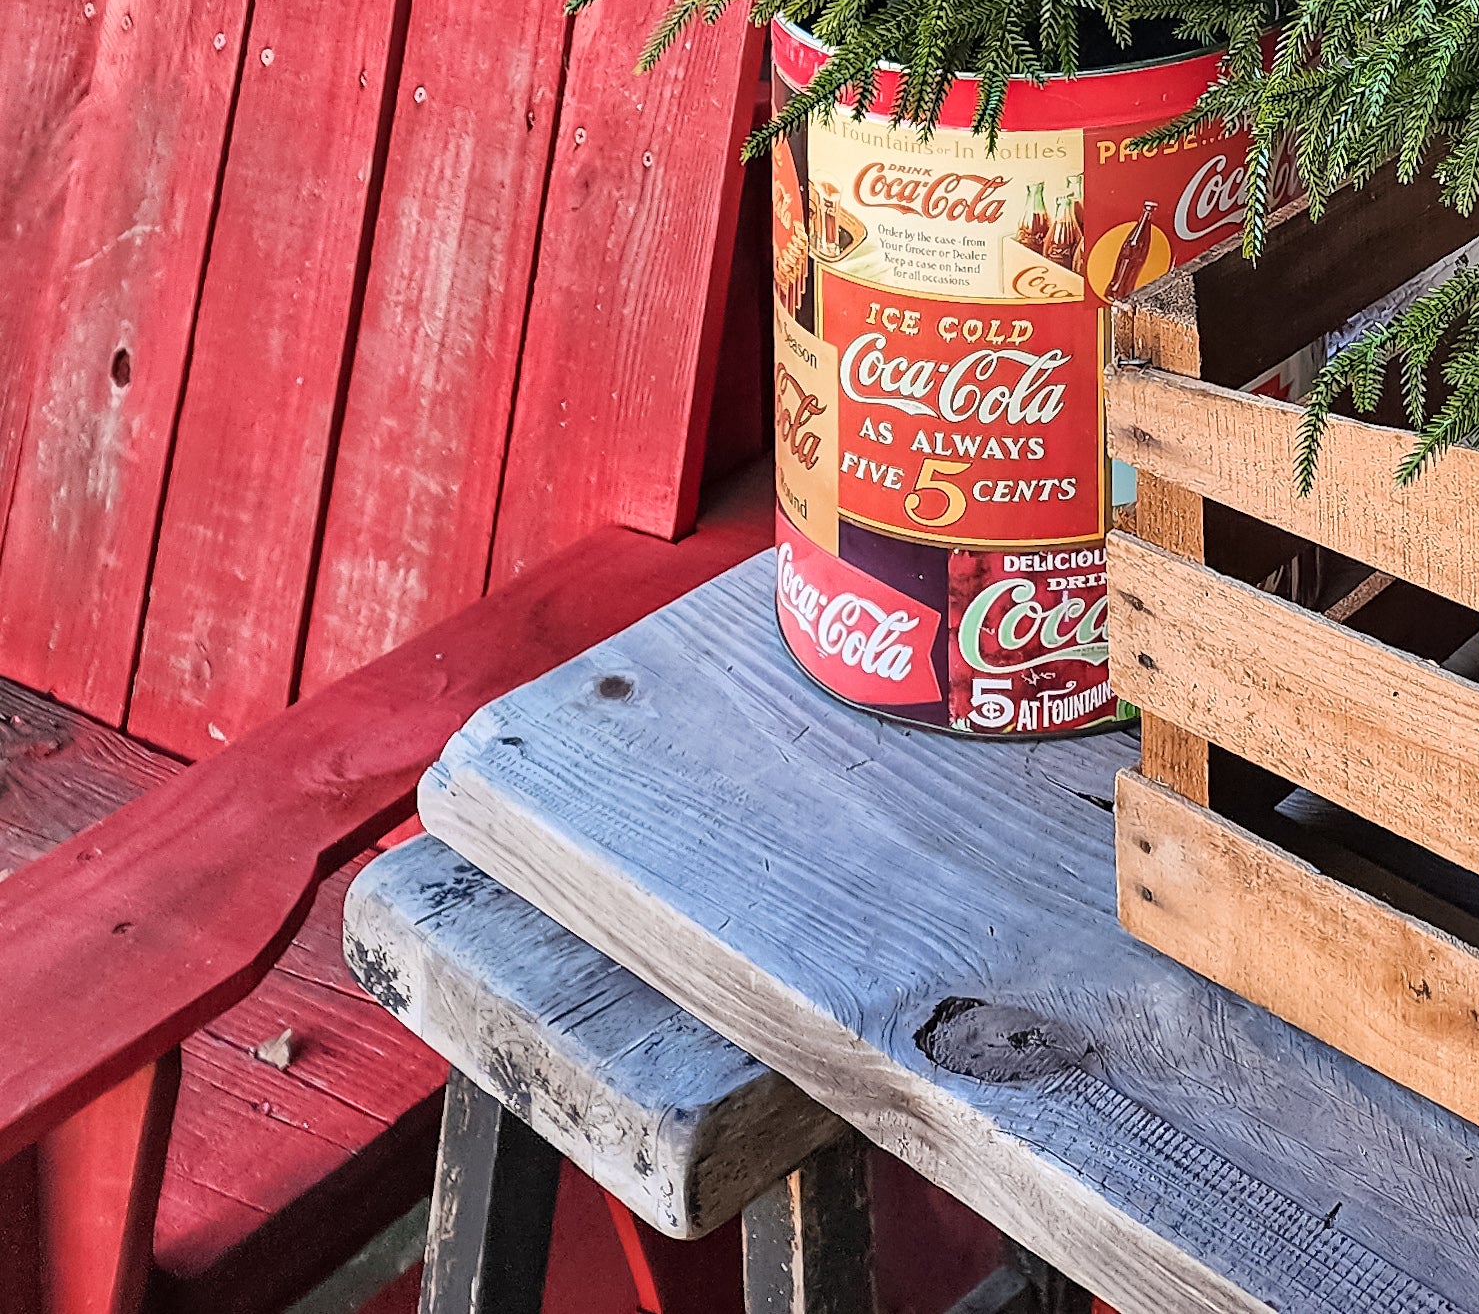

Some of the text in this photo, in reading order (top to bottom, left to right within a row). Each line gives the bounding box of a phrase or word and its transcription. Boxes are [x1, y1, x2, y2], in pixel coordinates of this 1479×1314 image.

[842, 121, 934, 155] Fountains
[936, 147, 951, 155] or
[955, 140, 974, 158] In
[1000, 141, 1068, 160] ottles
[888, 163, 933, 177] DRINK
[853, 162, 1013, 223] Coca-Cola
[878, 223, 903, 238] Order
[905, 229, 915, 242] by
[917, 232, 932, 243] the
[935, 235, 956, 245] case
[880, 238, 987, 261] Your Grocer or Dealer
[884, 252, 981, 274] Keep a case on hand
[893, 266, 971, 286] for all occasions
[865, 302, 1034, 346] ICE COLD
[839, 332, 1073, 425] Coca-Cola
[858, 417, 1046, 461] AS ALWAYS
[840, 451, 1078, 527] FIVE 5 CENTS
[1003, 548, 1108, 572] DELICIOU
[777, 542, 921, 682] Coca-Cola
[1016, 700, 1040, 732] AT
[1037, 680, 1115, 728] FOUNTAIN
